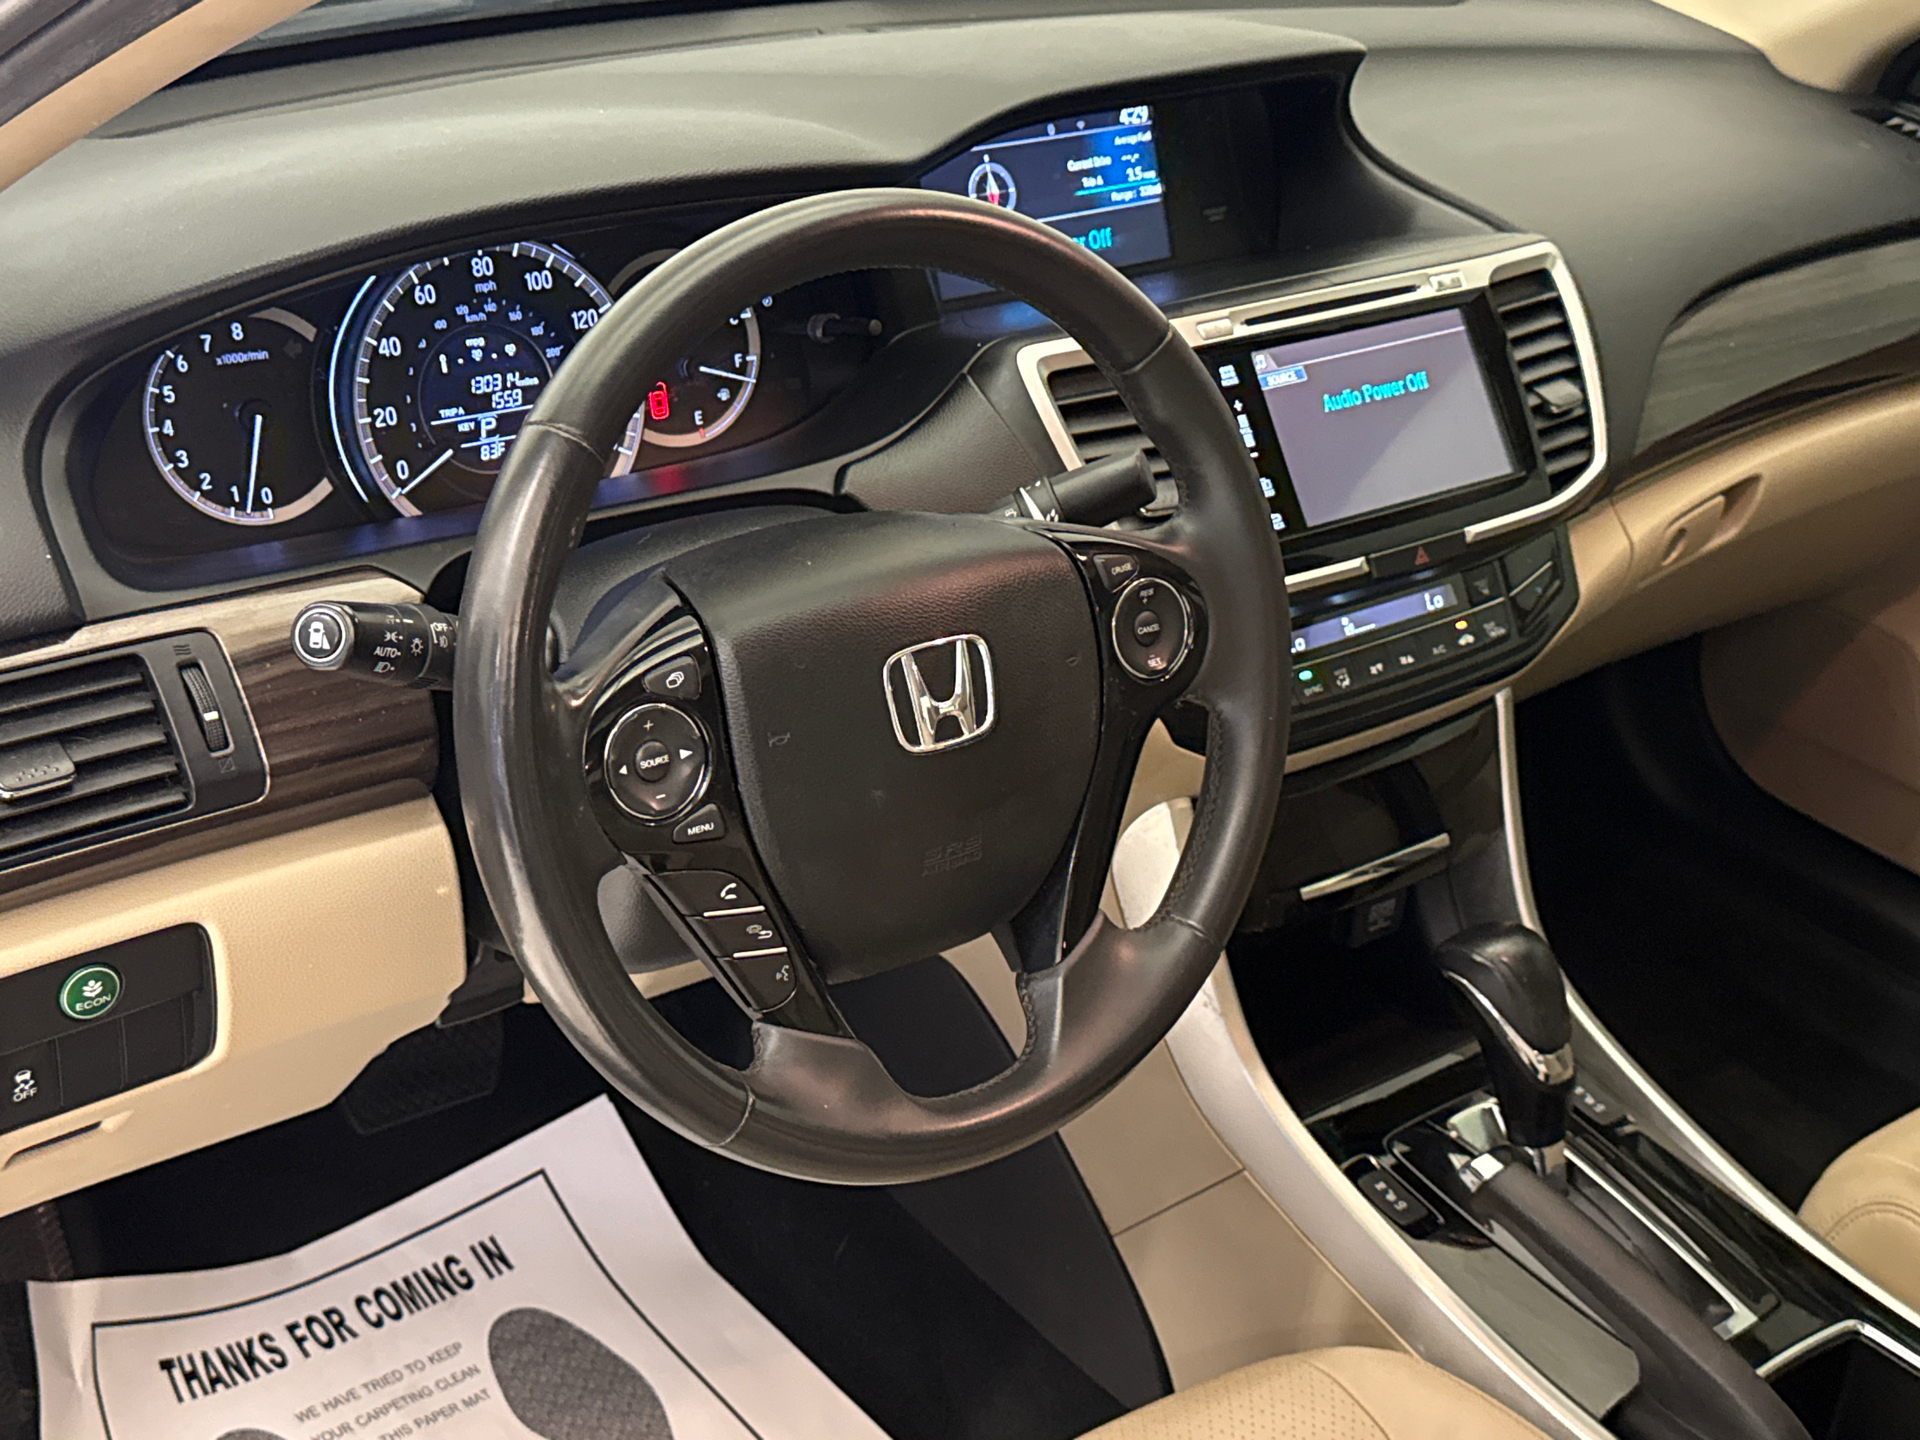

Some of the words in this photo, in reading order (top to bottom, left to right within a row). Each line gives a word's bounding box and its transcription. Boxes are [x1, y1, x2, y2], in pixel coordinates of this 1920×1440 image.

[1088, 226, 1113, 250] Off
[471, 256, 494, 278] 80
[474, 281, 497, 294] mph
[524, 270, 553, 292] 100
[414, 284, 436, 306] 60
[571, 308, 599, 330] 120
[230, 322, 244, 341] 8
[199, 333, 212, 353] 7
[378, 336, 401, 358] 40
[175, 354, 189, 373] 6
[734, 353, 743, 369] F
[162, 385, 176, 404] 5
[1322, 384, 1362, 413] Audio
[1362, 377, 1406, 405] Power
[1405, 370, 1430, 392] Off
[373, 406, 398, 428] 20
[694, 410, 704, 426] E
[162, 418, 174, 437] 4
[480, 417, 497, 438] P
[175, 450, 189, 469] 3
[396, 459, 409, 480] 0
[199, 472, 213, 491] 2
[230, 485, 240, 503] 1
[260, 486, 273, 504] 0
[373, 646, 398, 659] AUTO
[640, 753, 670, 770] SOURCE
[687, 822, 715, 836] MENU
[75, 993, 112, 1012] ECON
[13, 1087, 38, 1102] OFF
[158, 1331, 291, 1405] THANKS
[286, 1305, 361, 1360] FOR
[354, 1253, 475, 1331] COMING
[468, 1235, 516, 1282] IN
[295, 1404, 322, 1424] WE
[321, 1386, 361, 1413] HAVE
[361, 1367, 404, 1395] TRIED
[403, 1358, 427, 1376] TO
[427, 1341, 463, 1366] KEEP
[310, 1420, 357, 1440] YOUR
[354, 1384, 434, 1428] CARPETING
[434, 1363, 481, 1392] CLEAN
[378, 1422, 414, 1440] THIS
[413, 1401, 461, 1430] PAPER
[461, 1387, 492, 1409] MAT
